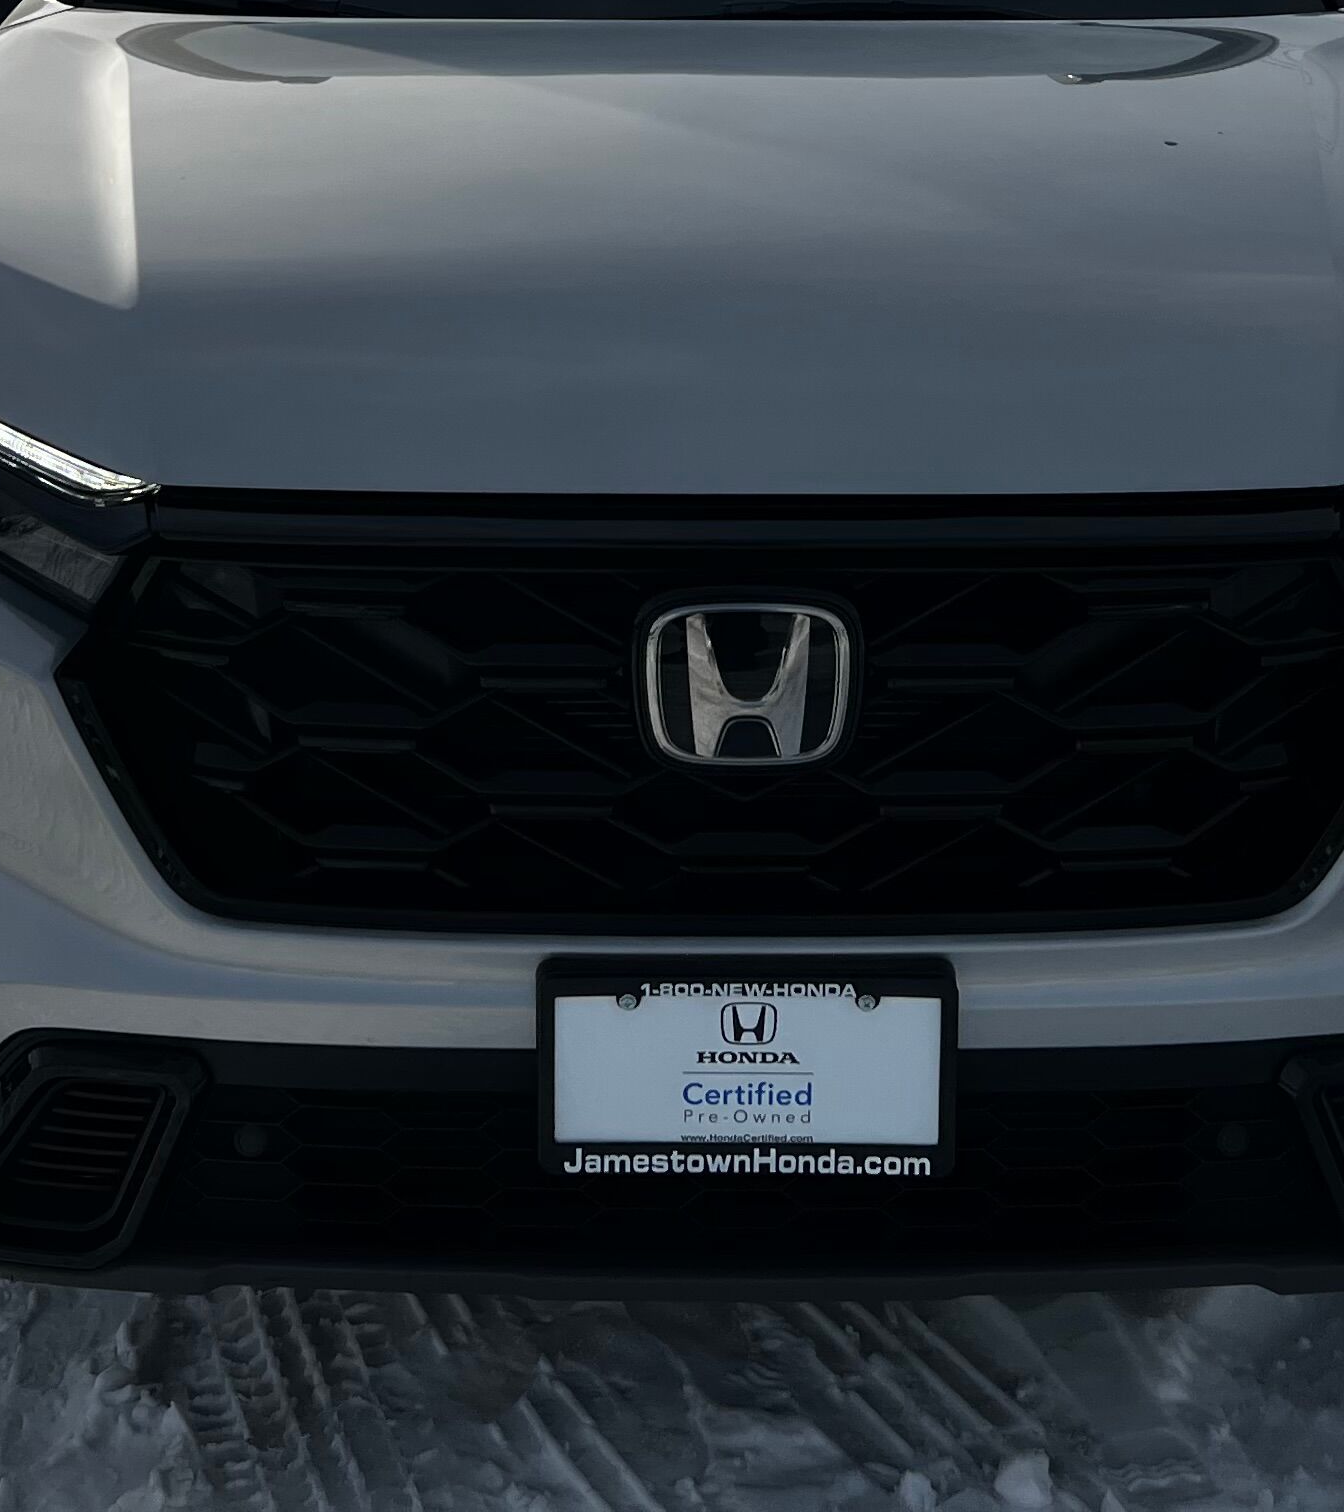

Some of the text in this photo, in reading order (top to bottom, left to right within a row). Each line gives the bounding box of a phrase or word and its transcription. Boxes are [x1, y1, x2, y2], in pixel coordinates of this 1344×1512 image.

[640, 983, 857, 998] 1-800-NEW-HONDA
[696, 1051, 799, 1065] HONDA
[682, 1082, 813, 1106] Certified
[683, 1109, 812, 1124] Pre-Owned
[564, 1148, 932, 1176] JamestownHonda.com
